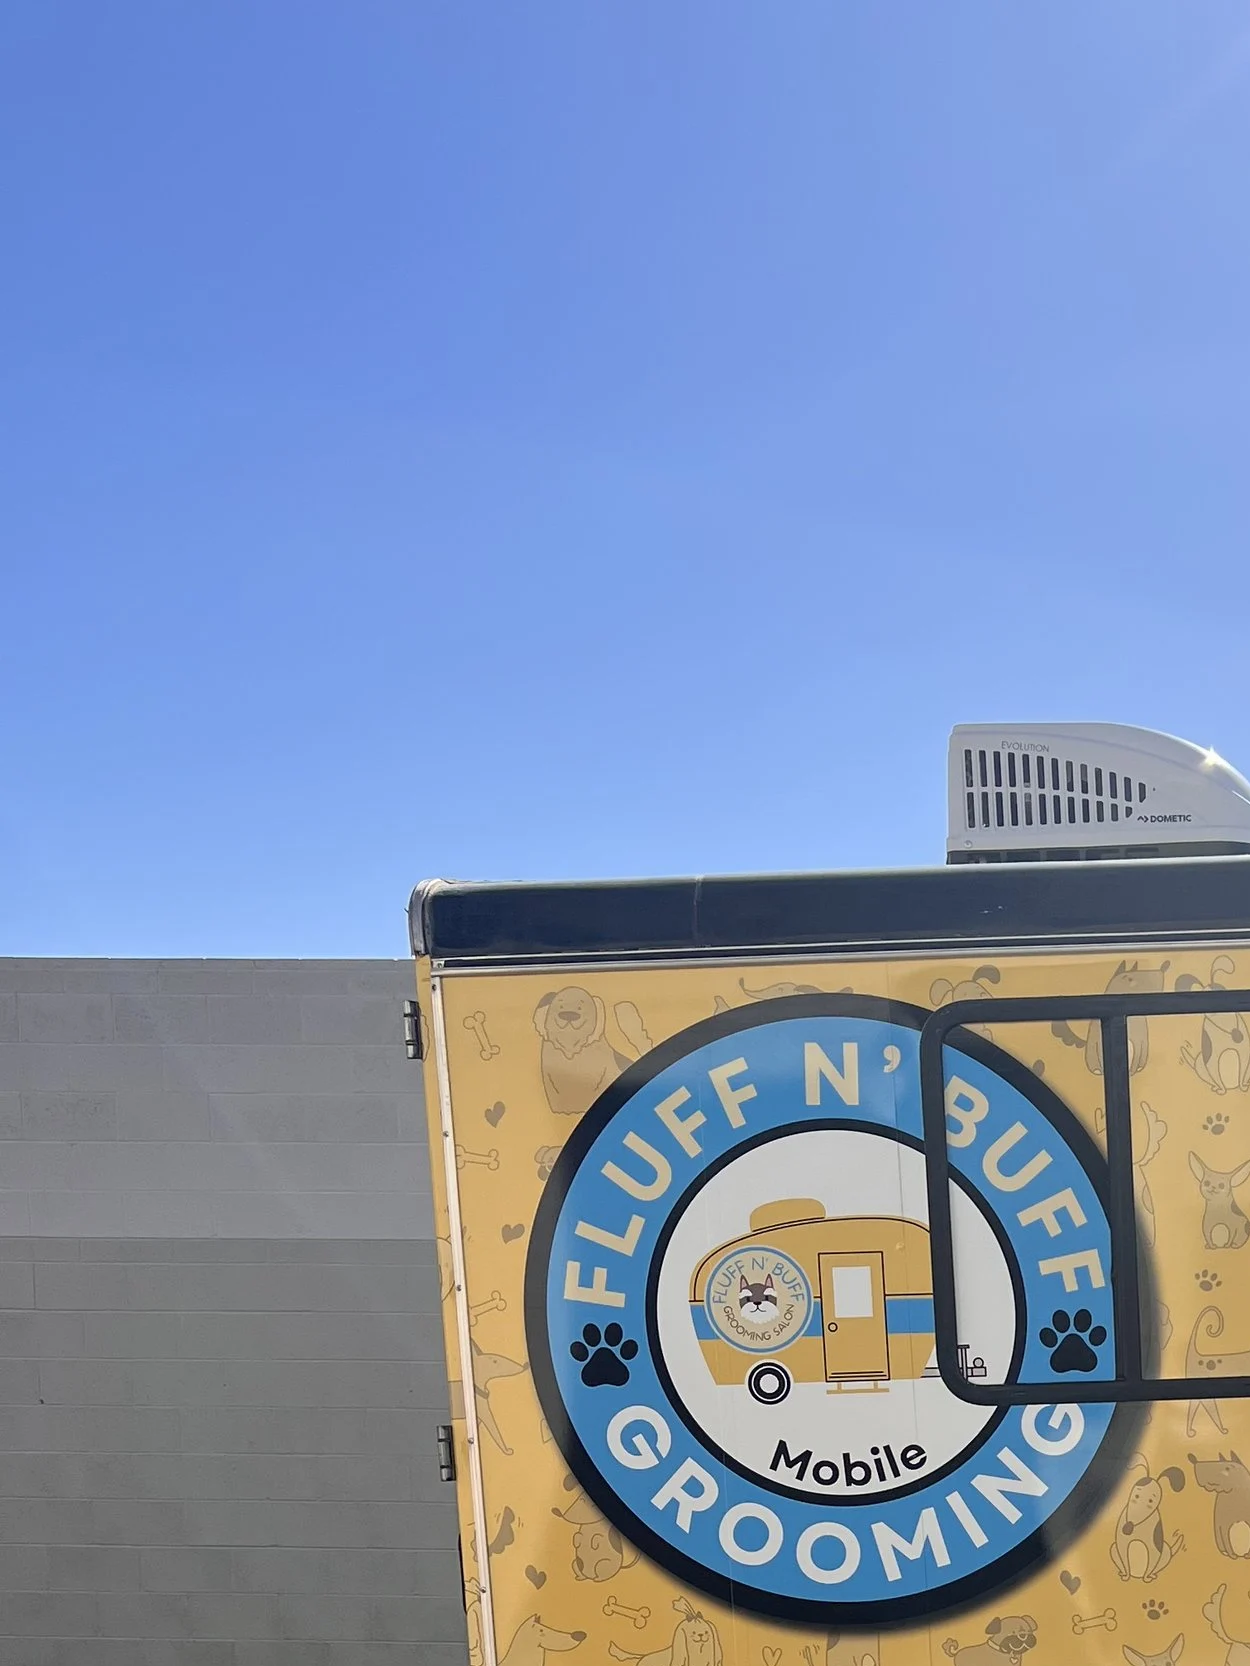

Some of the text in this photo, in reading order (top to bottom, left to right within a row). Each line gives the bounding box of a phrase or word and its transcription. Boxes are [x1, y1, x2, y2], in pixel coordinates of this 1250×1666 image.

[1001, 740, 1050, 752] EVOLUTION
[1150, 814, 1192, 823] DOMETIC
[564, 1057, 757, 1308] FLUFF
[945, 1075, 1106, 1293] BUFF
[712, 1260, 745, 1304] FLUFF
[772, 1262, 805, 1302] BUFF
[723, 1303, 795, 1341] GROOMING SALON
[769, 1439, 927, 1488] Mobile
[606, 1402, 1085, 1585] GROOMING
